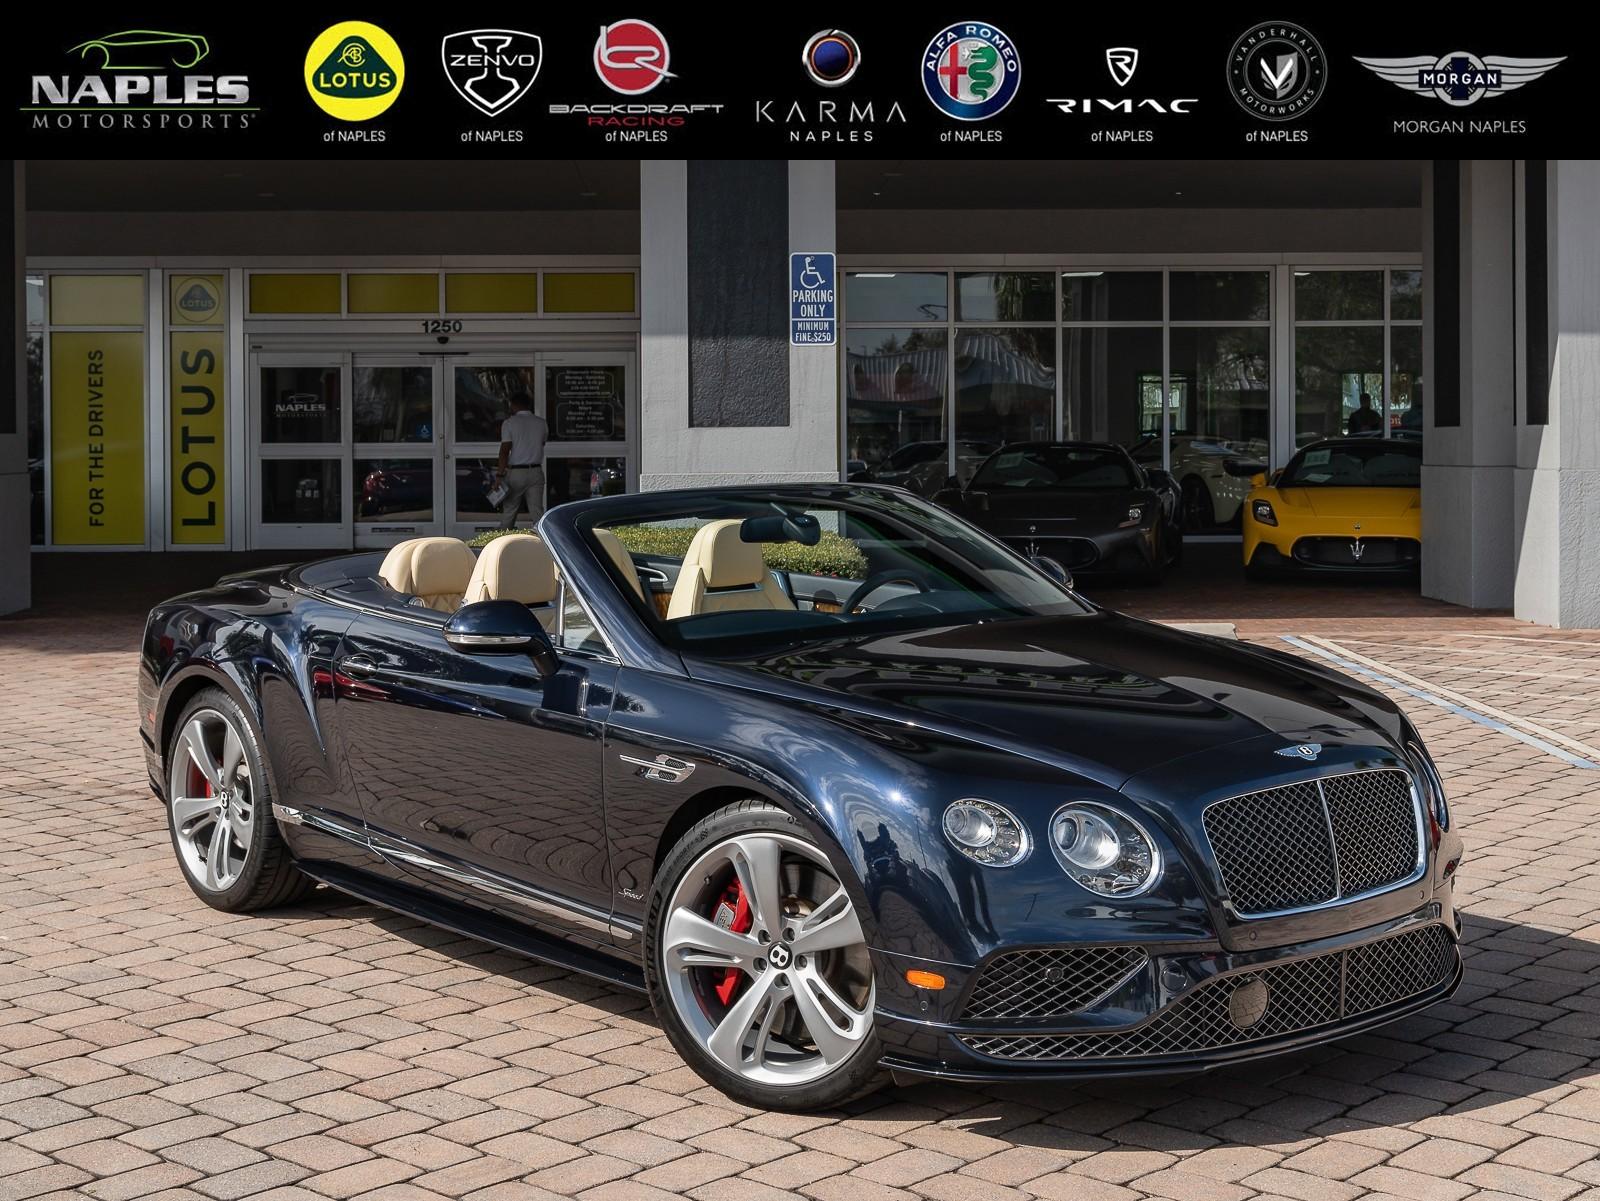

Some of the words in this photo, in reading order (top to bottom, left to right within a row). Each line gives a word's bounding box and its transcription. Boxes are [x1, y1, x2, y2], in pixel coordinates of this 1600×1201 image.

[793, 289, 833, 303] PARKING
[182, 299, 214, 308] LOTUS
[800, 304, 825, 317] ONLY
[422, 320, 462, 333] 1250
[797, 321, 829, 331] MINIMUM
[795, 332, 812, 342] FINE
[813, 332, 831, 342] $250
[89, 350, 104, 437] DRIVERS
[275, 403, 327, 412] NAPLES
[181, 348, 216, 526] LOTUS
[89, 443, 104, 482] THE
[89, 488, 104, 527] FOR
